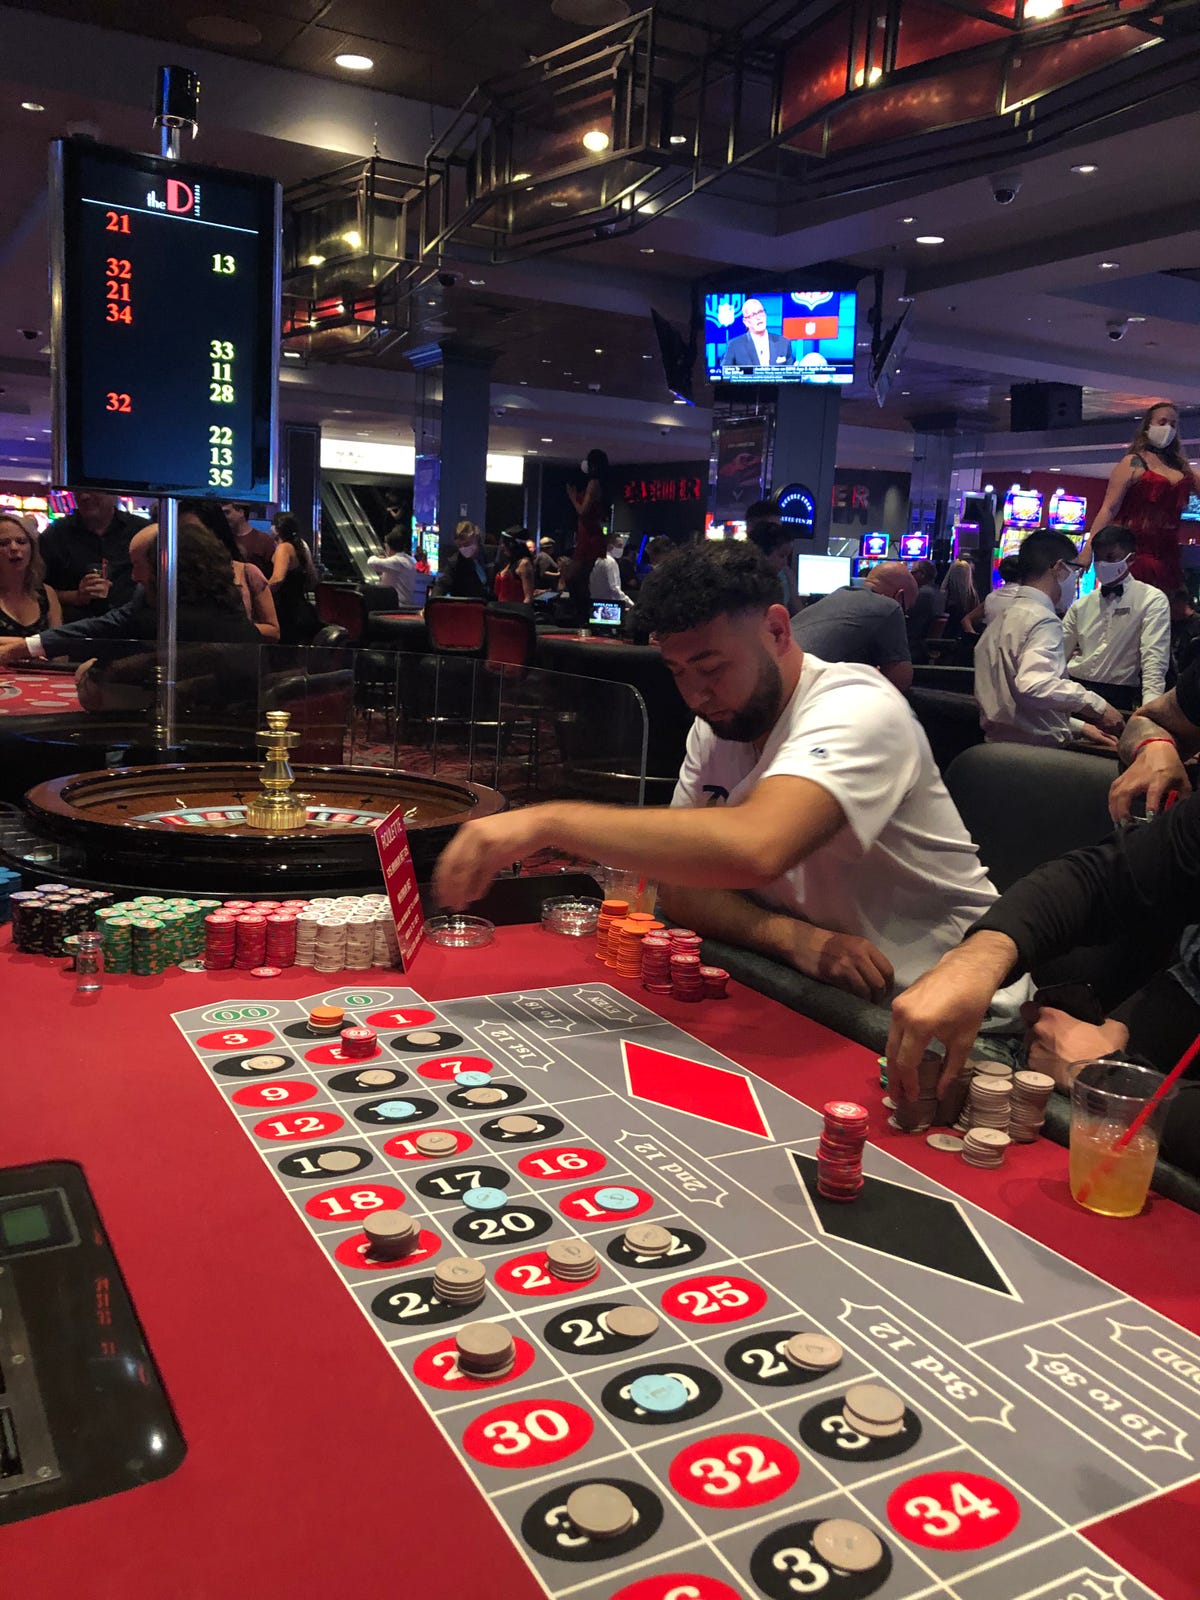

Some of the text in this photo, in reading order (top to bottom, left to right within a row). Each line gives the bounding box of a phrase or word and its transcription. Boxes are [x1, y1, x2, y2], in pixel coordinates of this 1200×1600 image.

[147, 179, 194, 213] the D
[105, 211, 132, 234] 21
[105, 258, 132, 279] 32
[211, 253, 236, 274] 13
[105, 280, 132, 302] 21
[105, 303, 133, 325] 34
[209, 340, 235, 360] 33
[211, 362, 233, 382] 11
[105, 392, 132, 413] 32
[209, 383, 234, 403] 28
[208, 425, 233, 445] 22
[210, 447, 233, 466] 13
[208, 468, 233, 487] 35
[212, 1007, 269, 1022] 00
[588, 997, 622, 1013] EVEN
[389, 1013, 412, 1025] 1
[222, 1033, 249, 1045] 3
[491, 1030, 537, 1059] 1st 12
[440, 1060, 463, 1074] 7
[260, 1087, 290, 1101] 9
[267, 1114, 324, 1138] 12
[529, 1153, 589, 1176] 16
[634, 1143, 708, 1192] 2nd 12
[429, 1171, 483, 1196] 17
[319, 1190, 386, 1216] 18
[469, 1212, 536, 1240] 20
[677, 1281, 750, 1317] 25
[869, 1322, 981, 1401] 3rd 12
[1044, 1361, 1166, 1441] 19 to 36
[483, 1409, 571, 1455] 30
[689, 1445, 782, 1496] 32
[904, 1481, 1000, 1538] 34
